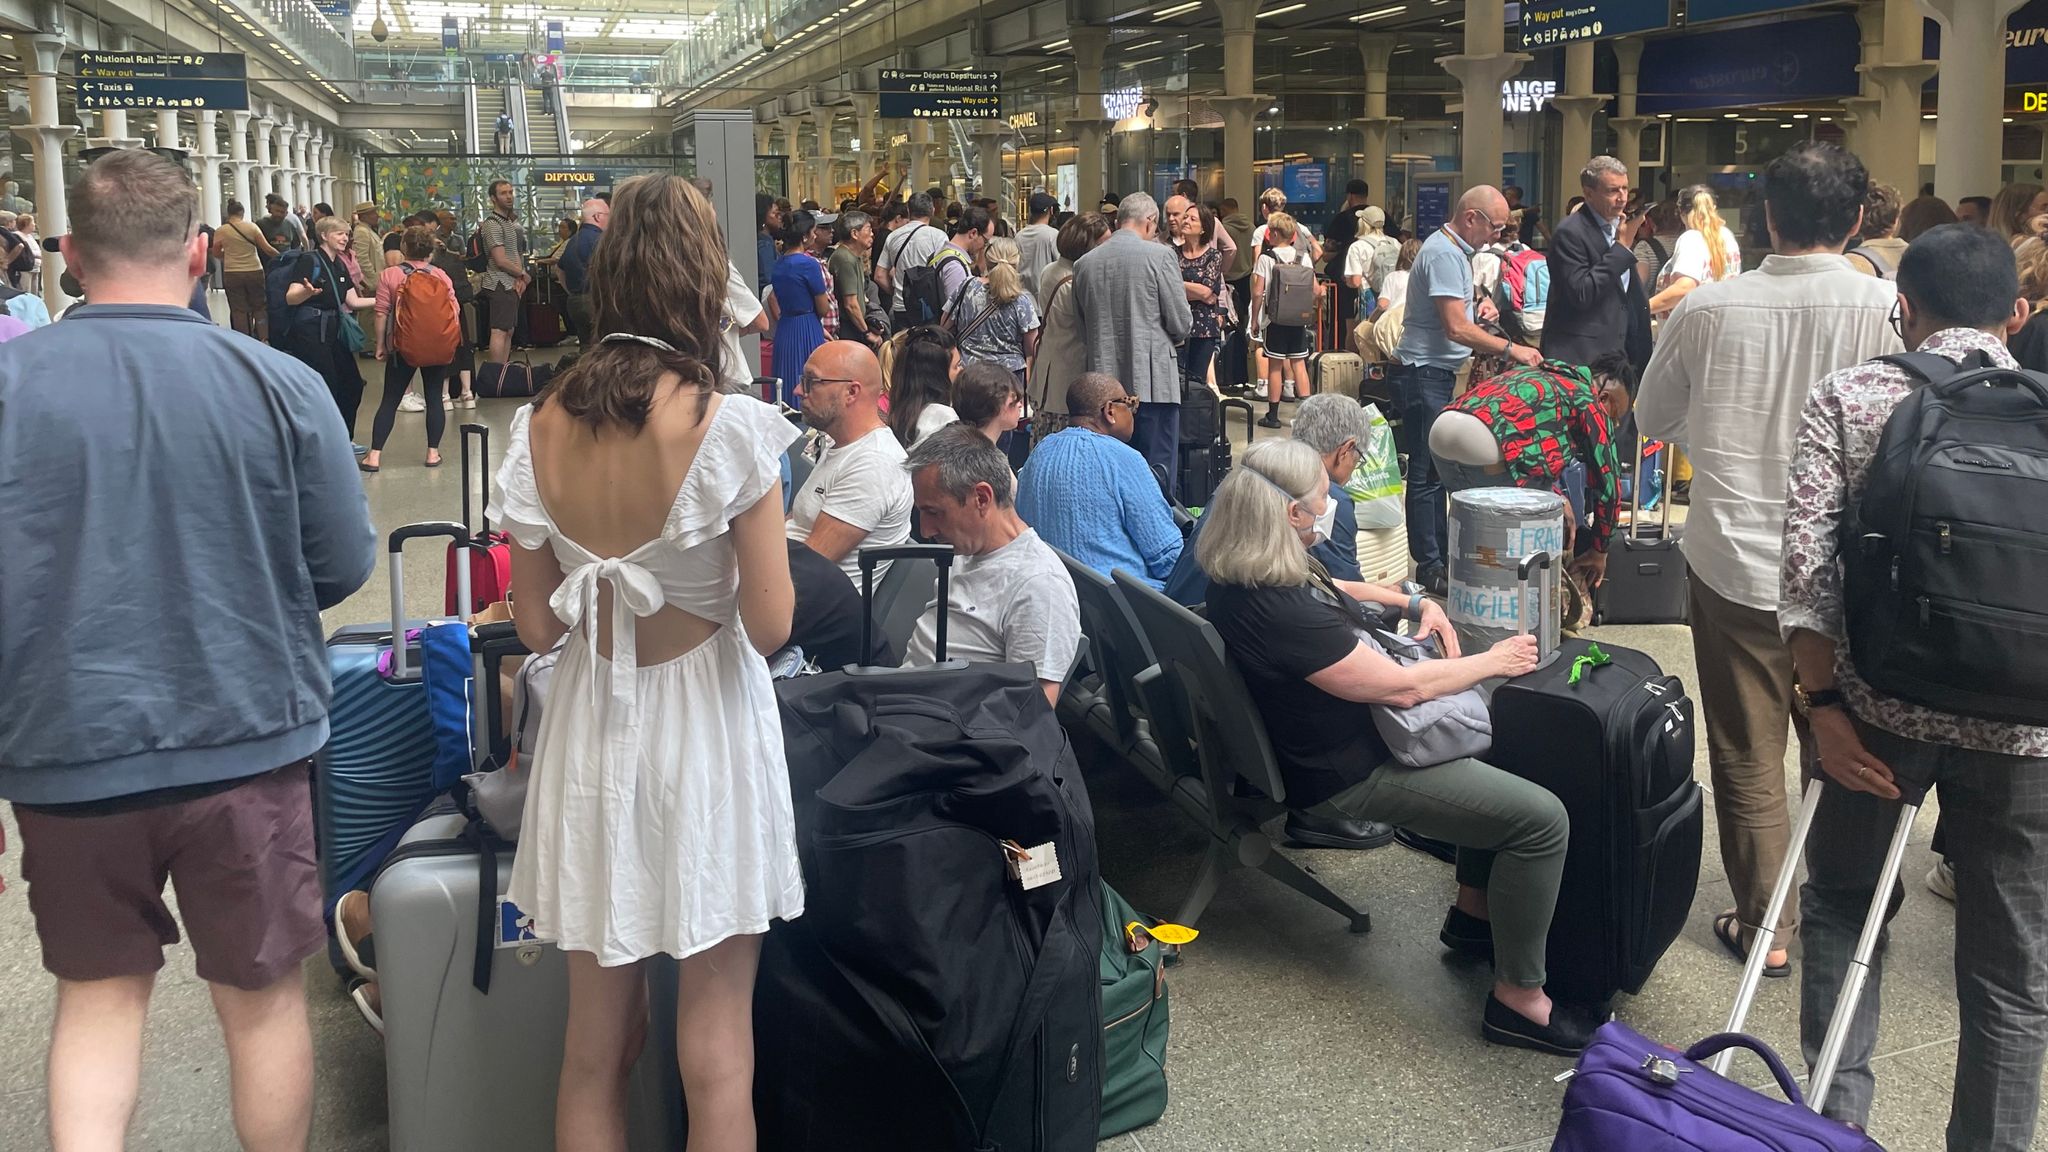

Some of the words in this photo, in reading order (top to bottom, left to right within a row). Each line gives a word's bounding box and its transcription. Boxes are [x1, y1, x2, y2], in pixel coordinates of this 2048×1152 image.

[1535, 11, 1550, 23] Way
[1551, 8, 1564, 19] out
[1552, 28, 1558, 42] P
[95, 54, 135, 64] National
[136, 55, 155, 64] Rail
[119, 69, 134, 77] out
[923, 71, 949, 80] Départs
[97, 82, 123, 91] Taxis
[945, 84, 973, 92] National
[1502, 80, 1556, 98] ANGE
[146, 97, 153, 106] P
[962, 97, 977, 105] Way
[1103, 87, 1143, 109] CHANGE
[1502, 96, 1544, 112] NEY
[949, 108, 955, 117] P
[1107, 103, 1139, 120] MONEY
[1010, 111, 1038, 130] CHANEL
[1735, 130, 1748, 154] 5
[544, 172, 596, 183] DIPTYQUE
